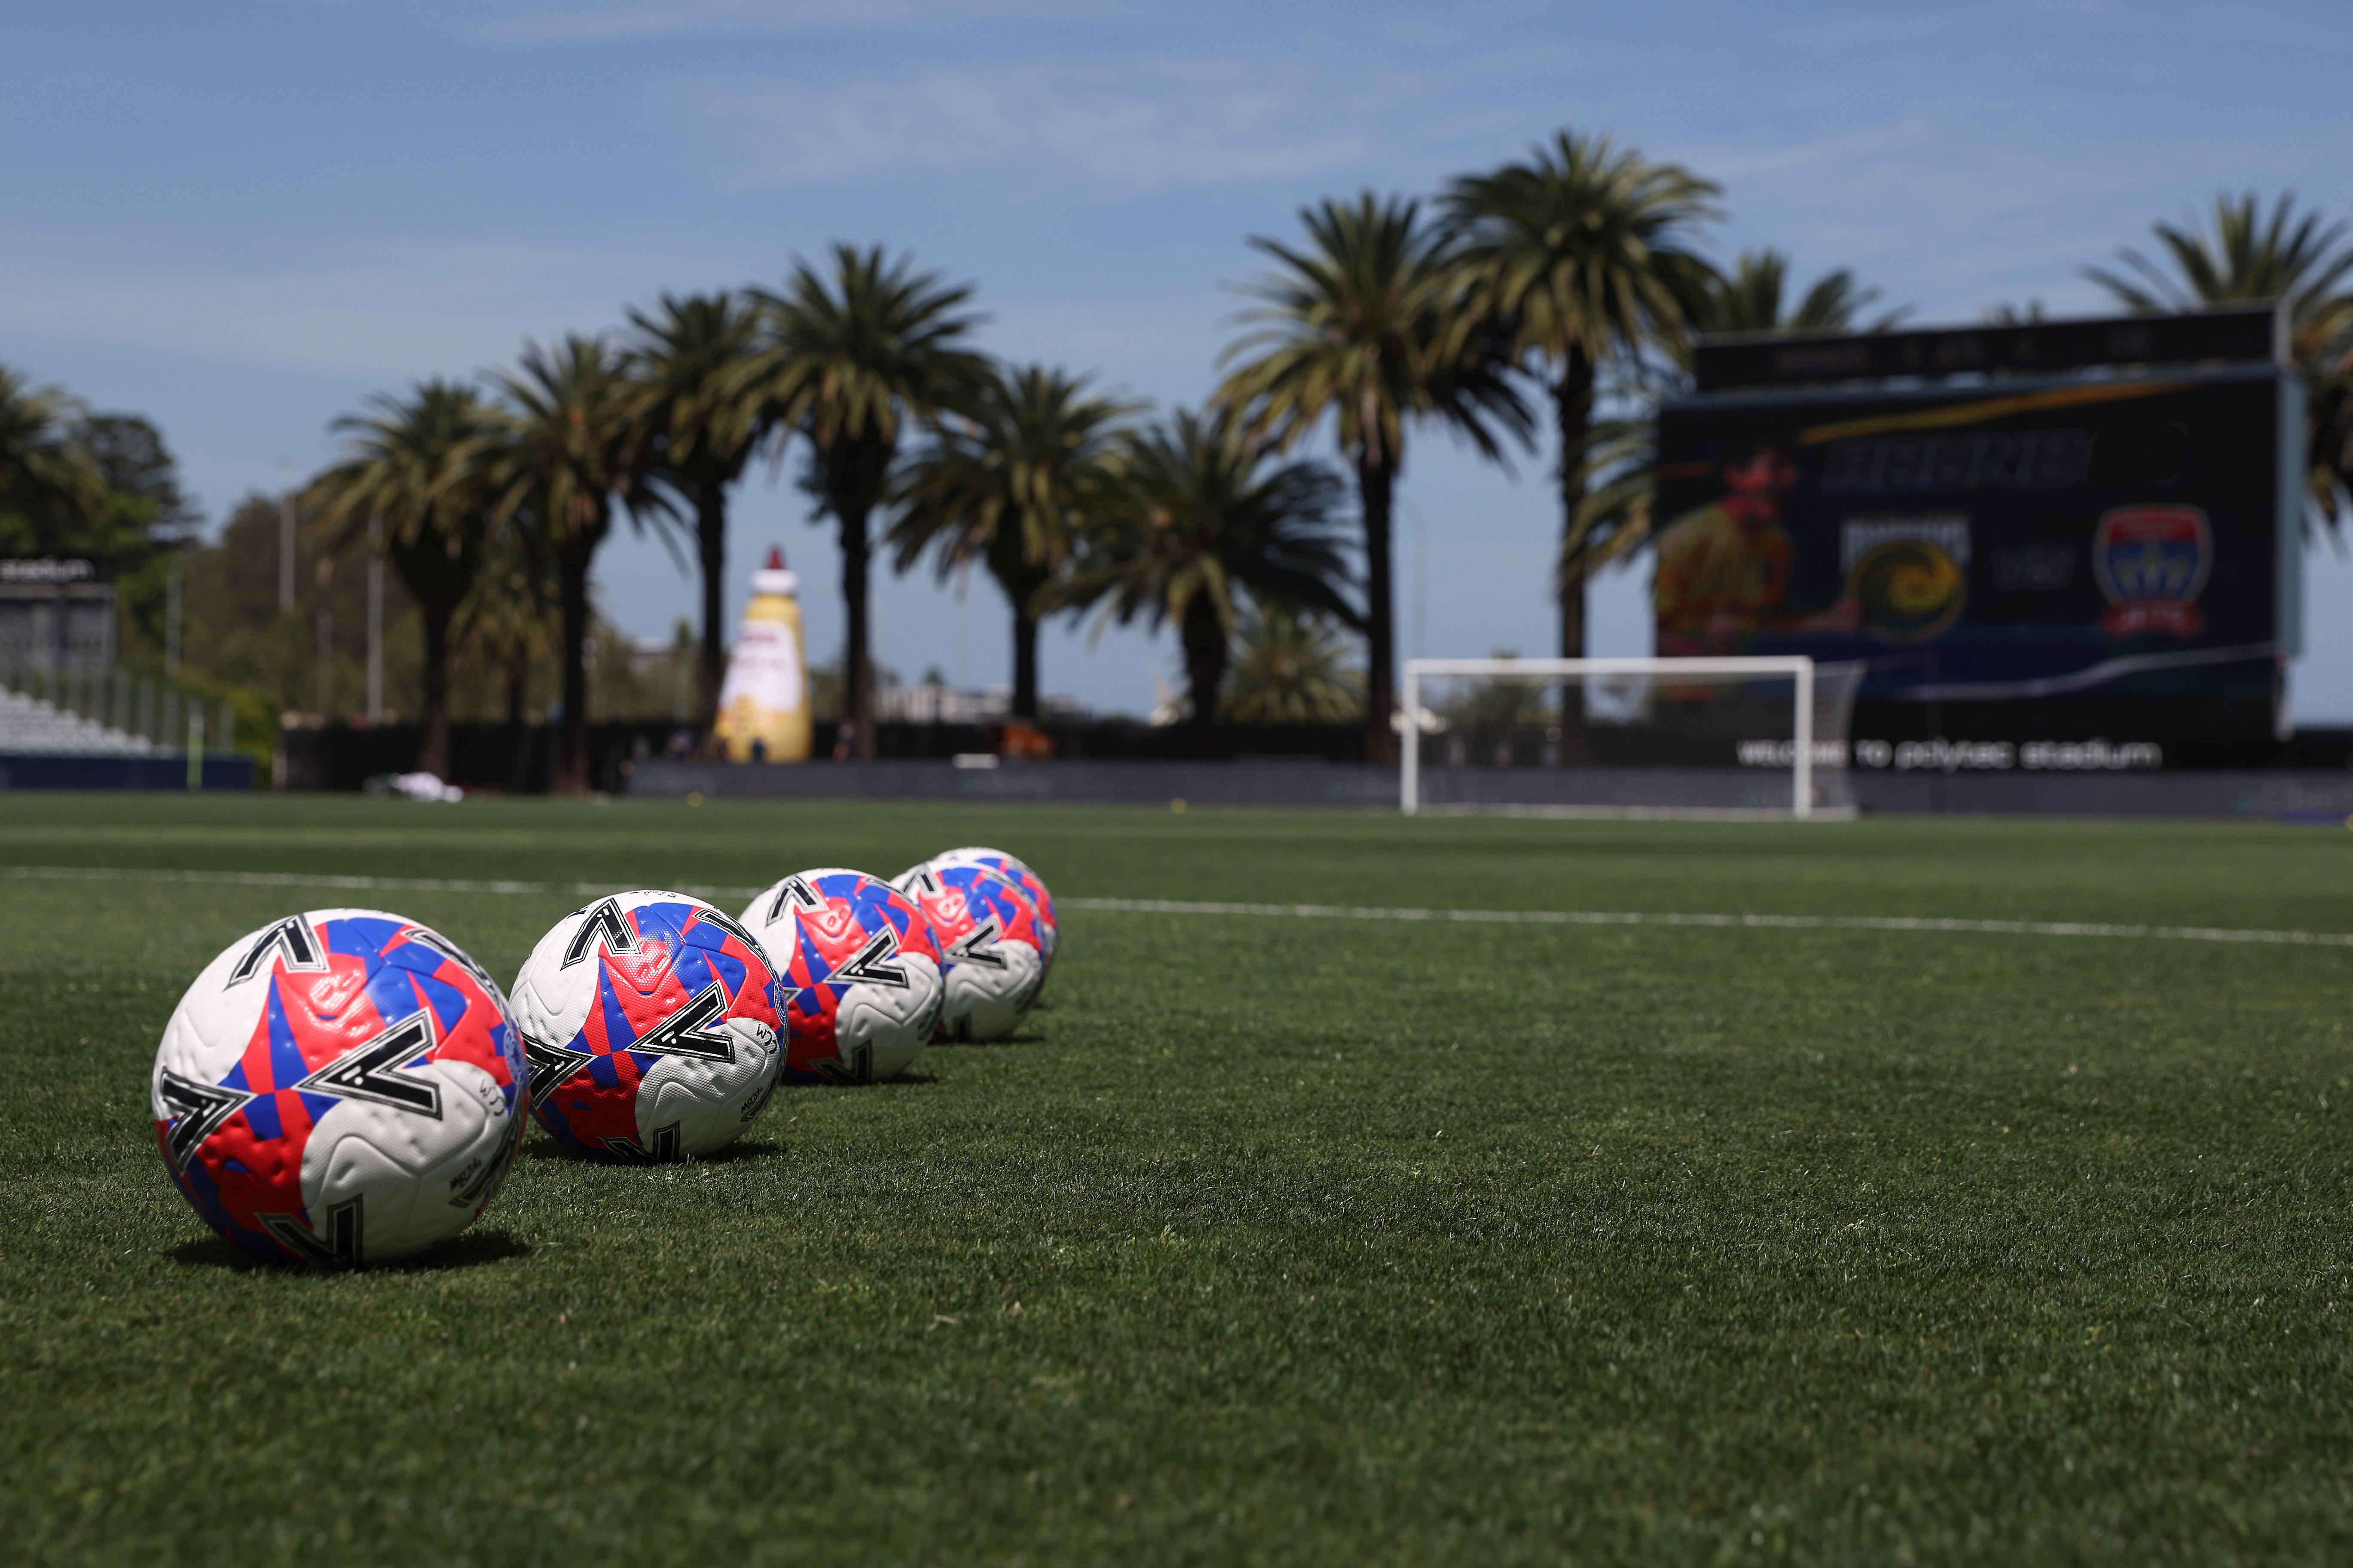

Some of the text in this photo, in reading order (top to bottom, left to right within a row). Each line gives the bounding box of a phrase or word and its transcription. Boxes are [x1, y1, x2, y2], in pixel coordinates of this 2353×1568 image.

[1736, 738, 1849, 768] WELCME
[1853, 738, 1893, 768] TO
[2020, 736, 2163, 770] stadium
